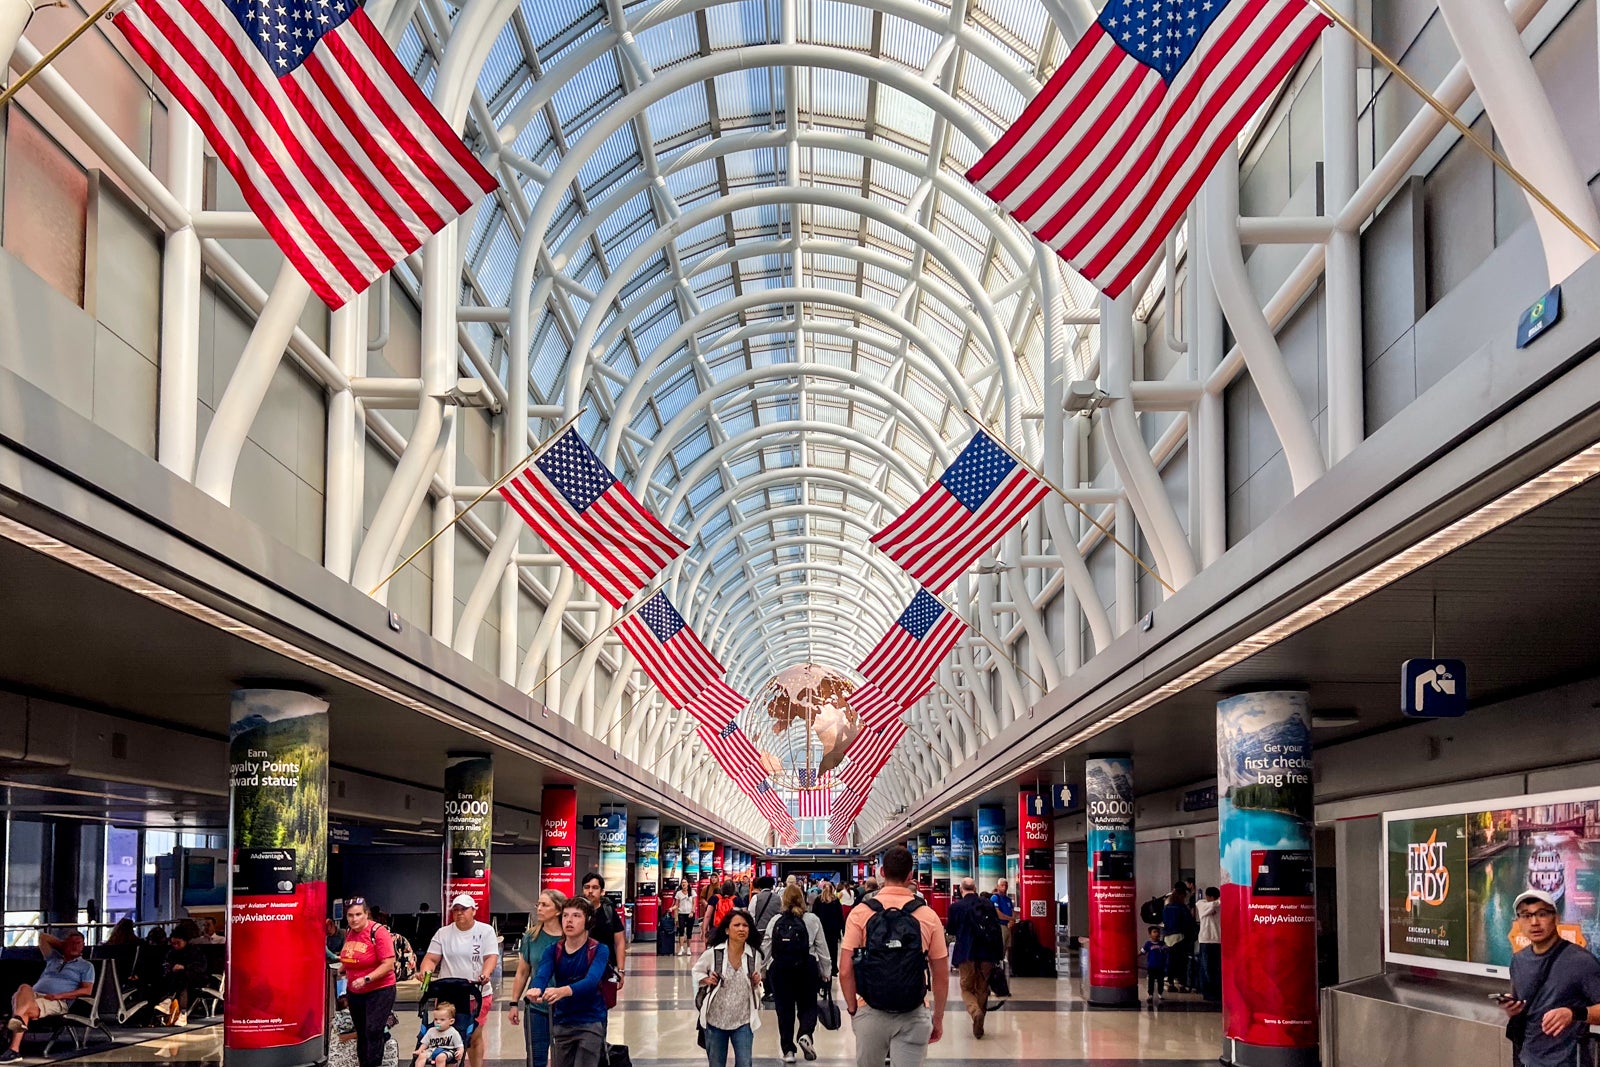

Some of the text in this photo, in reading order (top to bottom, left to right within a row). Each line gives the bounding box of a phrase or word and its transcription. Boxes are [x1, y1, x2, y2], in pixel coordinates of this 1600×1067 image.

[247, 748, 268, 758] Earn
[1264, 743, 1303, 755] Get your
[229, 760, 299, 775] oyalty Points
[1245, 756, 1270, 769] first
[229, 775, 259, 787] oward
[1257, 771, 1308, 787] bag free
[457, 792, 473, 800] Earn
[445, 800, 489, 815] 50,000
[1090, 800, 1134, 815] 50,000
[545, 818, 568, 829] Apply
[593, 817, 608, 827] K2
[1025, 821, 1049, 831] Apply
[545, 829, 568, 839] Today
[1025, 831, 1049, 841] Today
[936, 837, 946, 845] H3
[1408, 841, 1448, 871] FIRST
[1408, 872, 1448, 901] LADY
[231, 913, 294, 923] pplyAviator.com
[1408, 926, 1430, 934] CHICAGO'S
[1405, 936, 1437, 946] ARCHITECTURE
